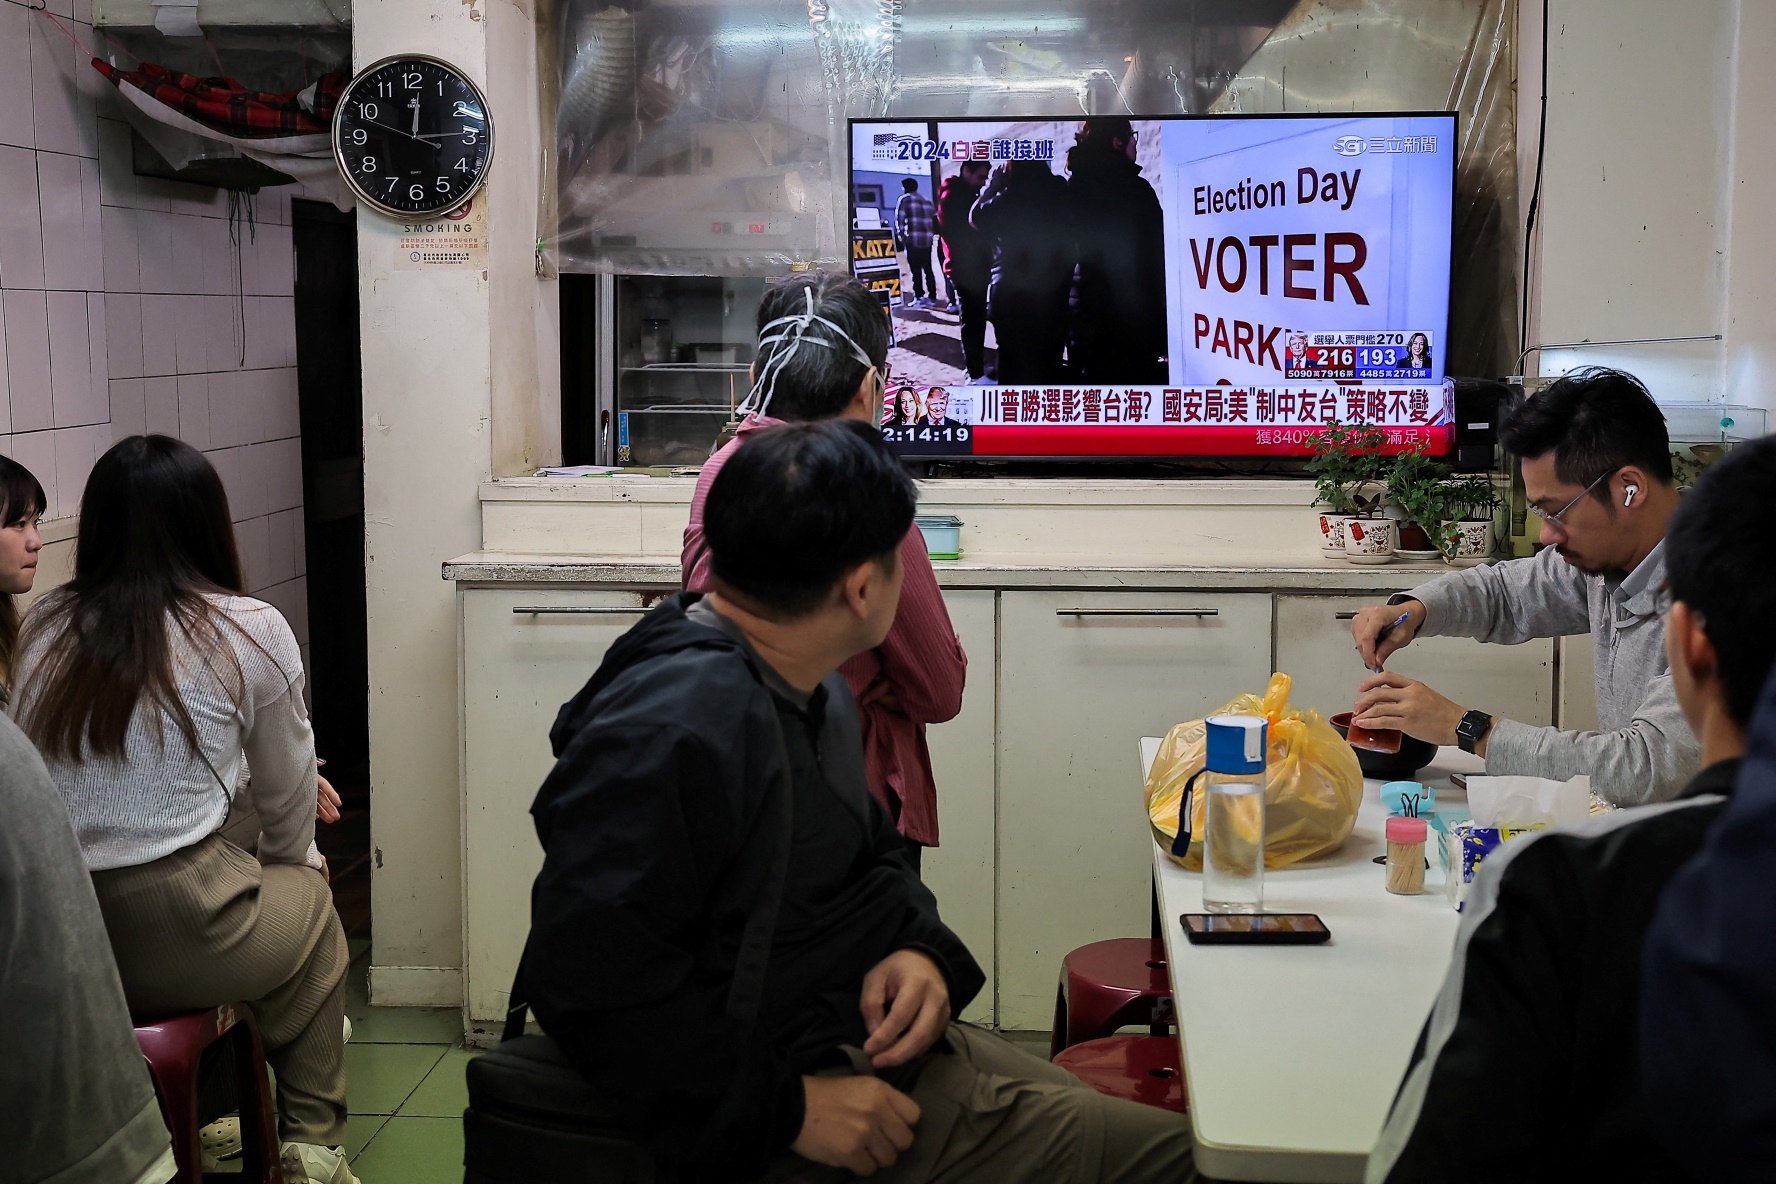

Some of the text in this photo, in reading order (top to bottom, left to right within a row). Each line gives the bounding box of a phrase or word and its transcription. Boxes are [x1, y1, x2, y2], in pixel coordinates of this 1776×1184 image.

[402, 72, 423, 89] 12
[436, 80, 443, 97] 1
[377, 81, 392, 98] 11
[358, 103, 378, 119] 10
[452, 100, 467, 117] 2
[352, 128, 368, 146] 9
[462, 128, 477, 145] 3
[1369, 136, 1438, 154] 三立新聞
[898, 139, 1054, 160] 2024白宮誰接班
[361, 156, 377, 173] 8
[453, 157, 469, 173] 4
[385, 176, 399, 193] 7
[409, 184, 424, 200] 6
[435, 176, 450, 193] 5
[1194, 166, 1361, 215] Election Day
[404, 224, 472, 233] SMOKING
[853, 239, 896, 259] KATZ
[1189, 232, 1370, 306] VOTER
[862, 278, 901, 296] ATZ
[1194, 312, 1286, 372] PARK
[1313, 333, 1404, 346] 選舉人票門檻270
[1316, 349, 1353, 366] 216
[1359, 349, 1396, 366] 193
[981, 389, 1152, 423] 川普勝選影響台海?
